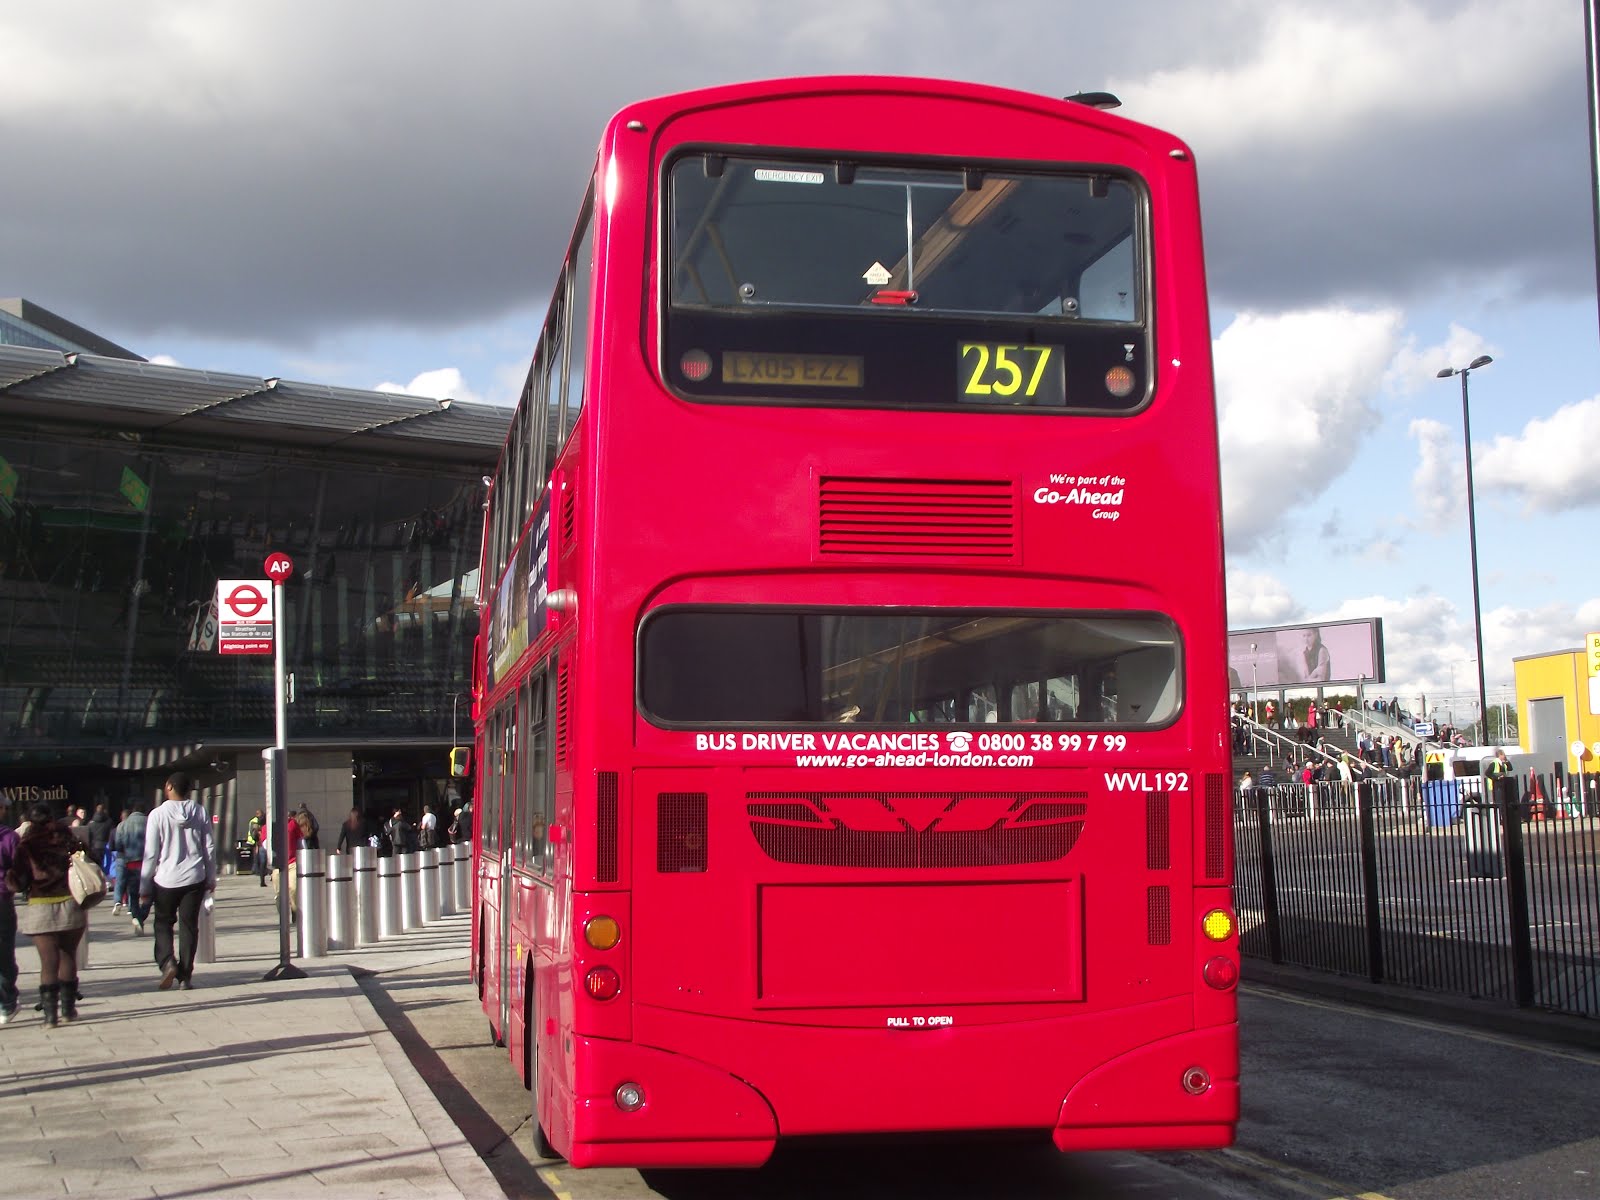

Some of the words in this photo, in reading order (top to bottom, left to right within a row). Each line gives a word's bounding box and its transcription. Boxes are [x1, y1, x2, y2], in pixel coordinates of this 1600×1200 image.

[733, 358, 795, 379] LX05
[803, 360, 849, 381] EZZ
[962, 344, 1052, 396] 257
[1049, 473, 1075, 484] We're
[1077, 475, 1098, 487] part
[1099, 474, 1111, 487] of
[1111, 475, 1126, 486] the
[1033, 487, 1124, 505] Go-Ahead
[1092, 508, 1120, 521] Group
[270, 560, 290, 573] AP
[696, 733, 736, 751] BUS
[742, 733, 816, 751] DRIVER
[822, 733, 939, 751] VACANCIES
[978, 734, 1025, 751] 0800
[1031, 734, 1053, 751] 38
[1058, 734, 1081, 751] 99
[1087, 734, 1099, 751] 7
[1103, 734, 1127, 752] 99
[796, 752, 1034, 768] www.go-ahead-london.com
[1104, 772, 1189, 792] WVL192
[887, 1017, 910, 1026] PULL
[912, 1016, 925, 1026] TO
[927, 1016, 953, 1025] OPEN
